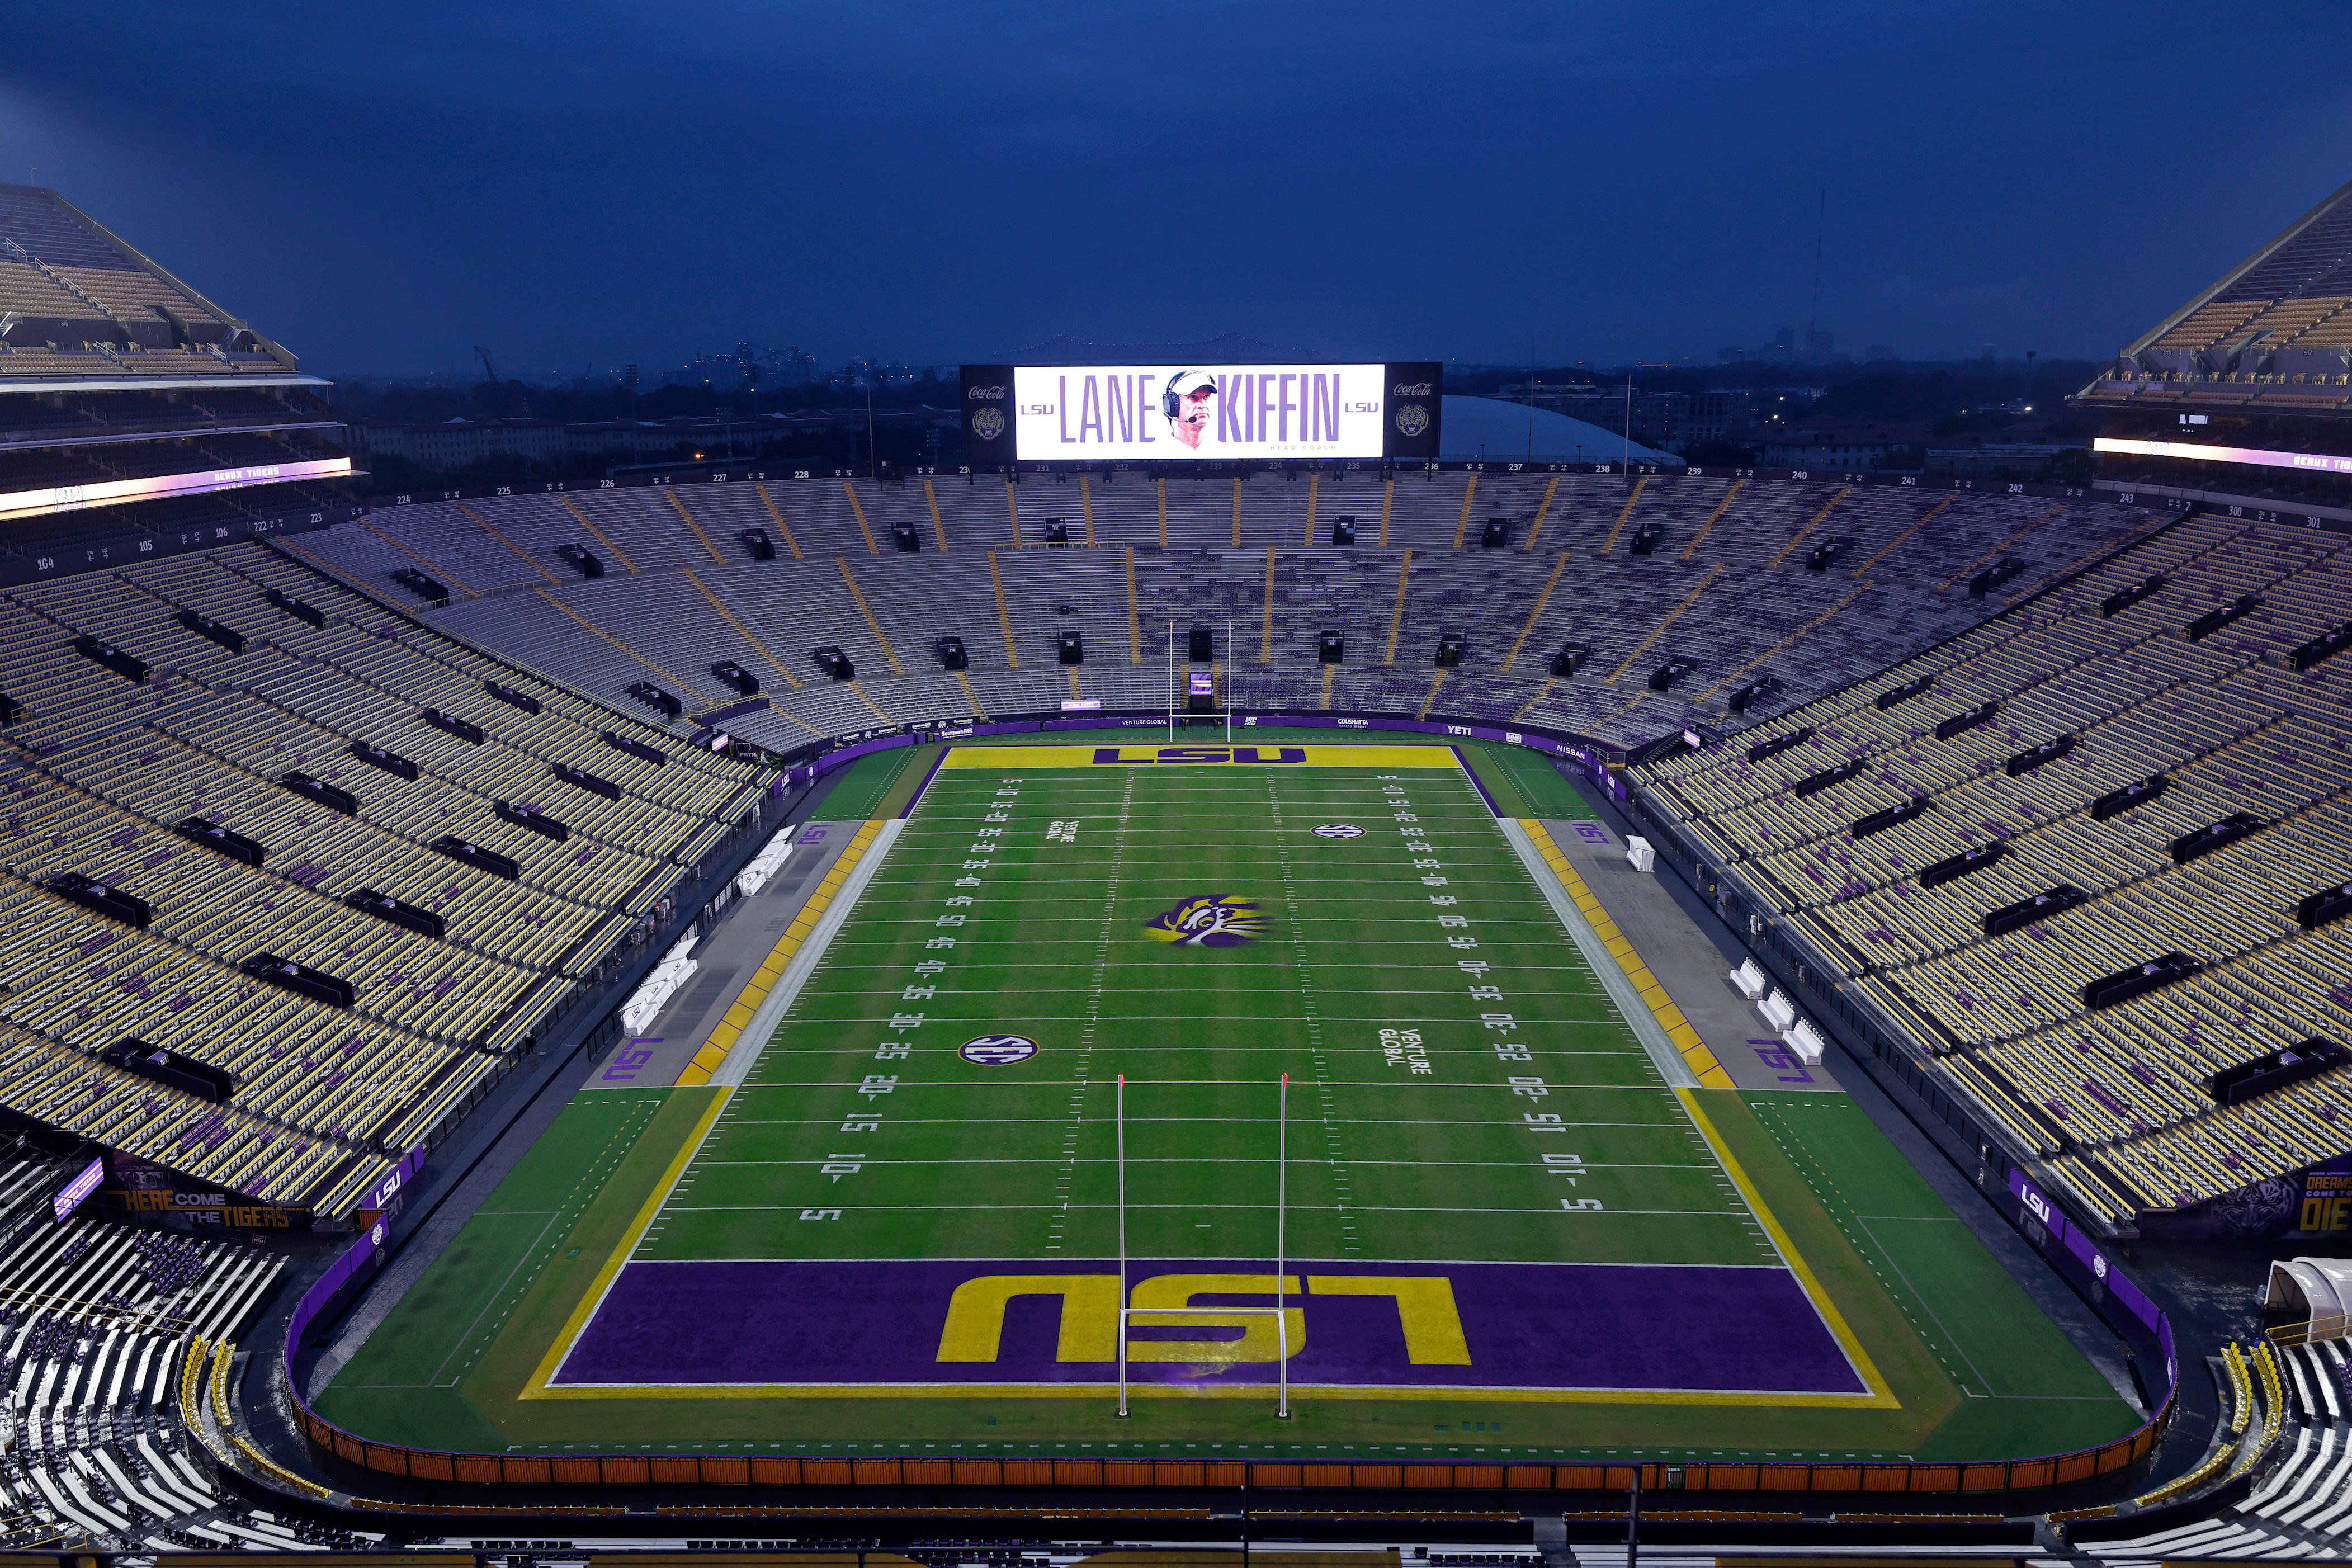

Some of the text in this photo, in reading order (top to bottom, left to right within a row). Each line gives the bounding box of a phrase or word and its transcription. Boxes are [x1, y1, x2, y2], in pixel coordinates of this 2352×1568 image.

[969, 386, 1006, 399] Coca-Cola
[1394, 382, 1433, 396] Coca-Cola
[1021, 405, 1054, 415] LSU
[1060, 374, 1339, 443] LANE KIFFIN
[1345, 403, 1378, 413] LSU
[497, 487, 511, 495] 225
[2008, 484, 2023, 493] 242
[397, 495, 410, 504] 224
[2120, 494, 2133, 503] 243
[2228, 506, 2242, 516] 300
[310, 513, 322, 523] 223
[2306, 517, 2320, 528] 301
[215, 527, 228, 538] 106
[254, 521, 267, 531] 222
[139, 540, 153, 551] 105
[37, 557, 54, 570] 104
[1447, 725, 1471, 735] YETI
[1093, 748, 1306, 764] LSU
[1557, 744, 1585, 759] NISSAN
[1393, 813, 1418, 821] 20
[797, 825, 833, 844] LSU
[977, 828, 1002, 837] 25
[1046, 821, 1064, 839] GLOBAL
[1060, 821, 1079, 843] VENTURE
[1314, 825, 1363, 838] SEC
[1400, 828, 1425, 837] 25
[1572, 824, 1610, 843] LSU
[970, 843, 995, 852] 30
[1406, 843, 1433, 852] 30
[962, 859, 989, 869] 35
[1413, 859, 1441, 869] 35
[954, 877, 981, 886] 40
[1421, 877, 1448, 886] 40
[945, 895, 973, 906] 45
[1429, 895, 1458, 906] 45
[936, 915, 966, 927] 50
[1438, 915, 1468, 927] 50
[925, 937, 956, 948] 45
[1447, 937, 1479, 950] 45
[913, 960, 946, 973] 40
[1457, 960, 1490, 974] 40
[901, 985, 936, 1000] 35
[1468, 985, 1504, 1000] 35
[632, 1007, 640, 1018] LSU
[888, 1013, 924, 1028] 30
[1480, 1013, 1517, 1029] 30
[874, 1042, 912, 1059] 25
[965, 1037, 1033, 1063] SEC
[1378, 1028, 1406, 1066] GLOBAL
[1400, 1028, 1432, 1075] VENTURE
[1493, 1043, 1533, 1061] 25
[602, 1038, 665, 1080] LSU
[1746, 1039, 1815, 1083] LSU
[858, 1075, 898, 1093] 20
[1508, 1076, 1550, 1095] 20
[840, 1113, 882, 1132] 15
[1523, 1113, 1567, 1132] 15
[820, 1154, 866, 1173] 10
[1541, 1154, 1588, 1174] 10
[375, 1170, 401, 1208] LSU
[2306, 1177, 2352, 1189] DREAMS
[124, 1190, 226, 1211] HERE COME
[1560, 1199, 1605, 1210] 5
[2021, 1184, 2049, 1222] LSU
[185, 1207, 289, 1227] THE TIGERS
[799, 1210, 842, 1220] 5
[2299, 1198, 2351, 1231] DIE
[936, 1274, 1471, 1365] LSU
